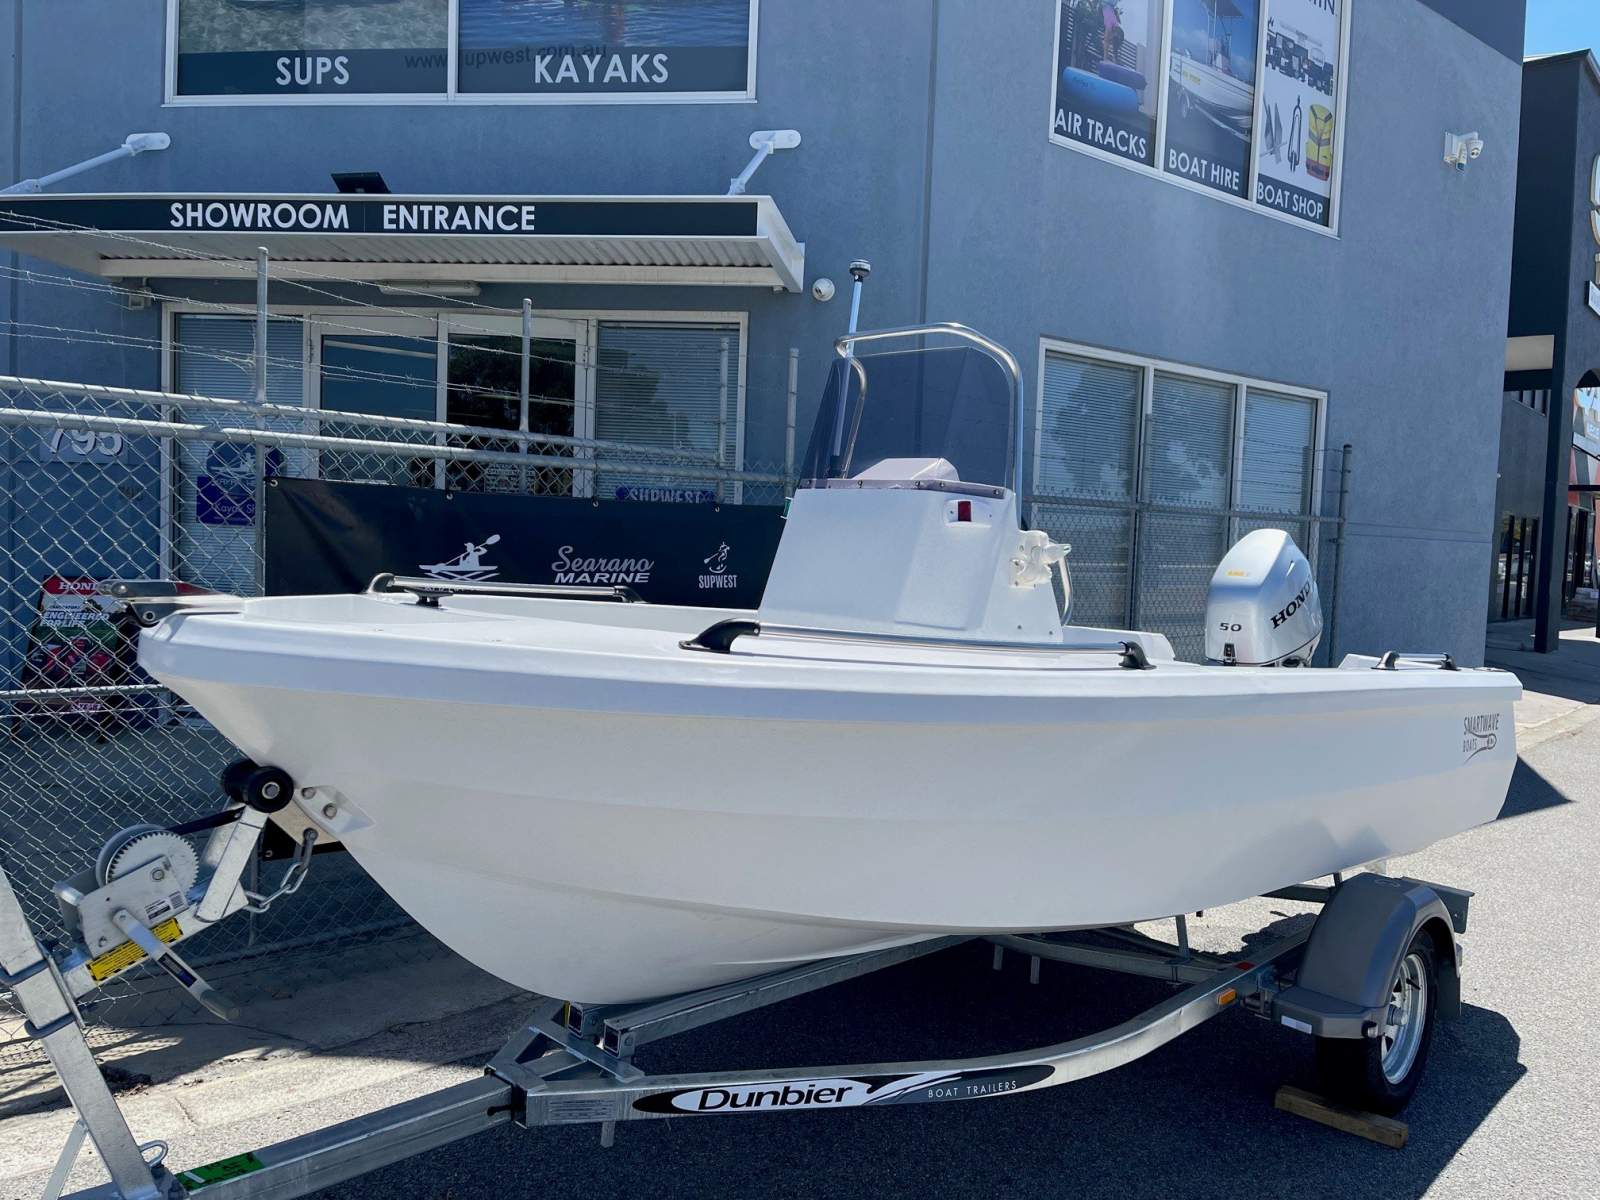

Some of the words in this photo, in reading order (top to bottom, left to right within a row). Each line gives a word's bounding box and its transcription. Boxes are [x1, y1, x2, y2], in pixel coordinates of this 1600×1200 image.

[275, 55, 350, 86] SUPS
[534, 53, 670, 84] KAYAKS
[1054, 108, 1082, 137] AIR
[1087, 117, 1147, 159] TRACKS
[1168, 148, 1208, 179] BOAT
[1210, 163, 1240, 191] HIRE
[1257, 181, 1290, 209] BOAT
[1292, 194, 1324, 219] SHOP
[170, 202, 350, 229] SHOWROOM
[383, 204, 535, 231] ENTRANCE
[551, 545, 655, 572] Searano
[554, 572, 651, 585] MARINE
[698, 574, 738, 589] SUPWEST
[1270, 582, 1311, 630] HOND
[1219, 622, 1242, 632] 50
[1463, 713, 1500, 735] SMARTWAVE
[698, 1083, 853, 1111] Dunbier
[927, 1087, 959, 1099] BOAT
[966, 1080, 1018, 1096] TRAILERS
